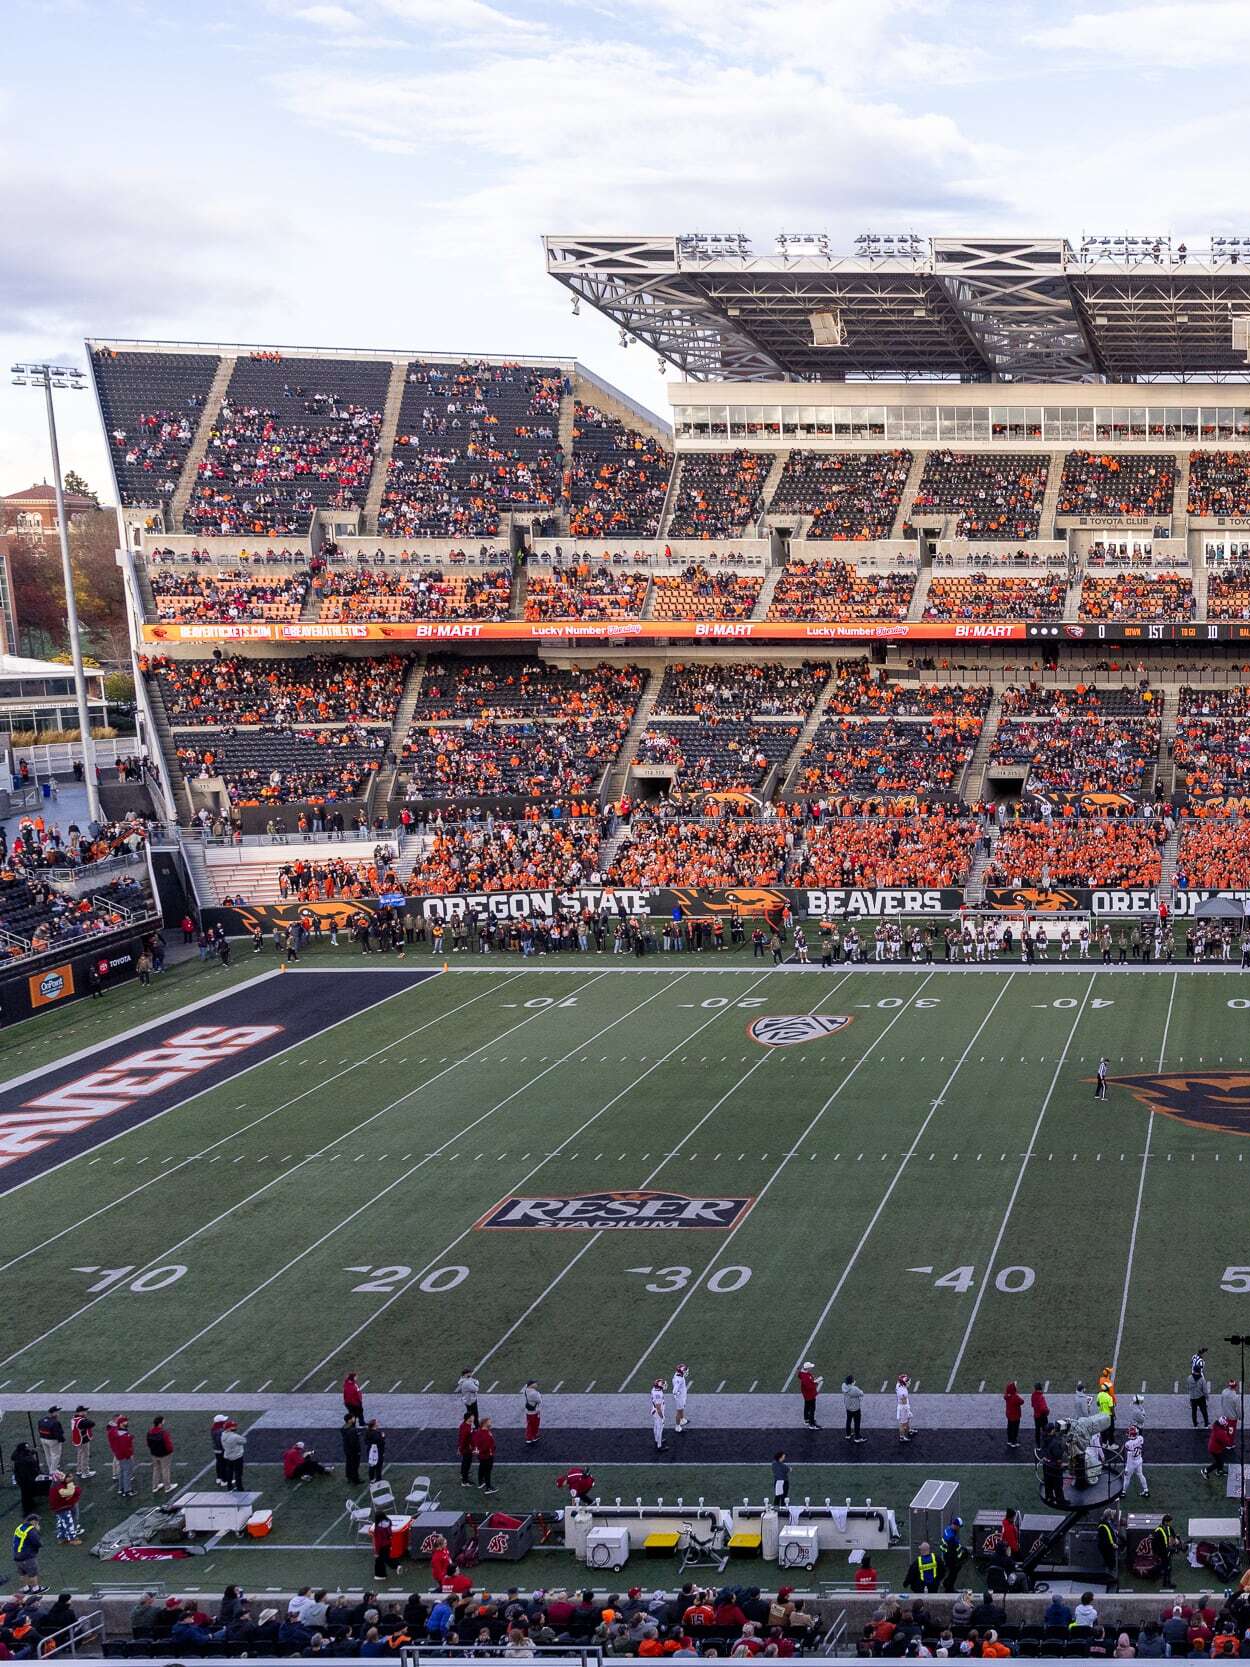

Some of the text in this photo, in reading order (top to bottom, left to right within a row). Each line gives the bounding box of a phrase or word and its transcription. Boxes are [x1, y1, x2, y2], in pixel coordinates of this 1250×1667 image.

[1090, 517, 1149, 526] TOYOTA CLUB
[532, 626, 563, 636] Lucky
[566, 627, 606, 635] Number
[807, 627, 835, 636] Lucky
[838, 627, 875, 636] Number
[1098, 625, 1106, 638] 0
[1149, 625, 1164, 638] 1ST
[1208, 625, 1218, 638] 10
[423, 889, 650, 922] OREGON STATE
[806, 891, 941, 914] BEAVERS
[1092, 892, 1209, 915] OREON
[110, 955, 131, 968] TOYOTA
[41, 976, 63, 991] OnPoint
[499, 1200, 735, 1221] RESER
[535, 1220, 680, 1229] STADIUM
[86, 1265, 188, 1292] 10
[351, 1265, 469, 1292] 20
[645, 1265, 752, 1292] 30
[933, 1266, 1035, 1293] 40
